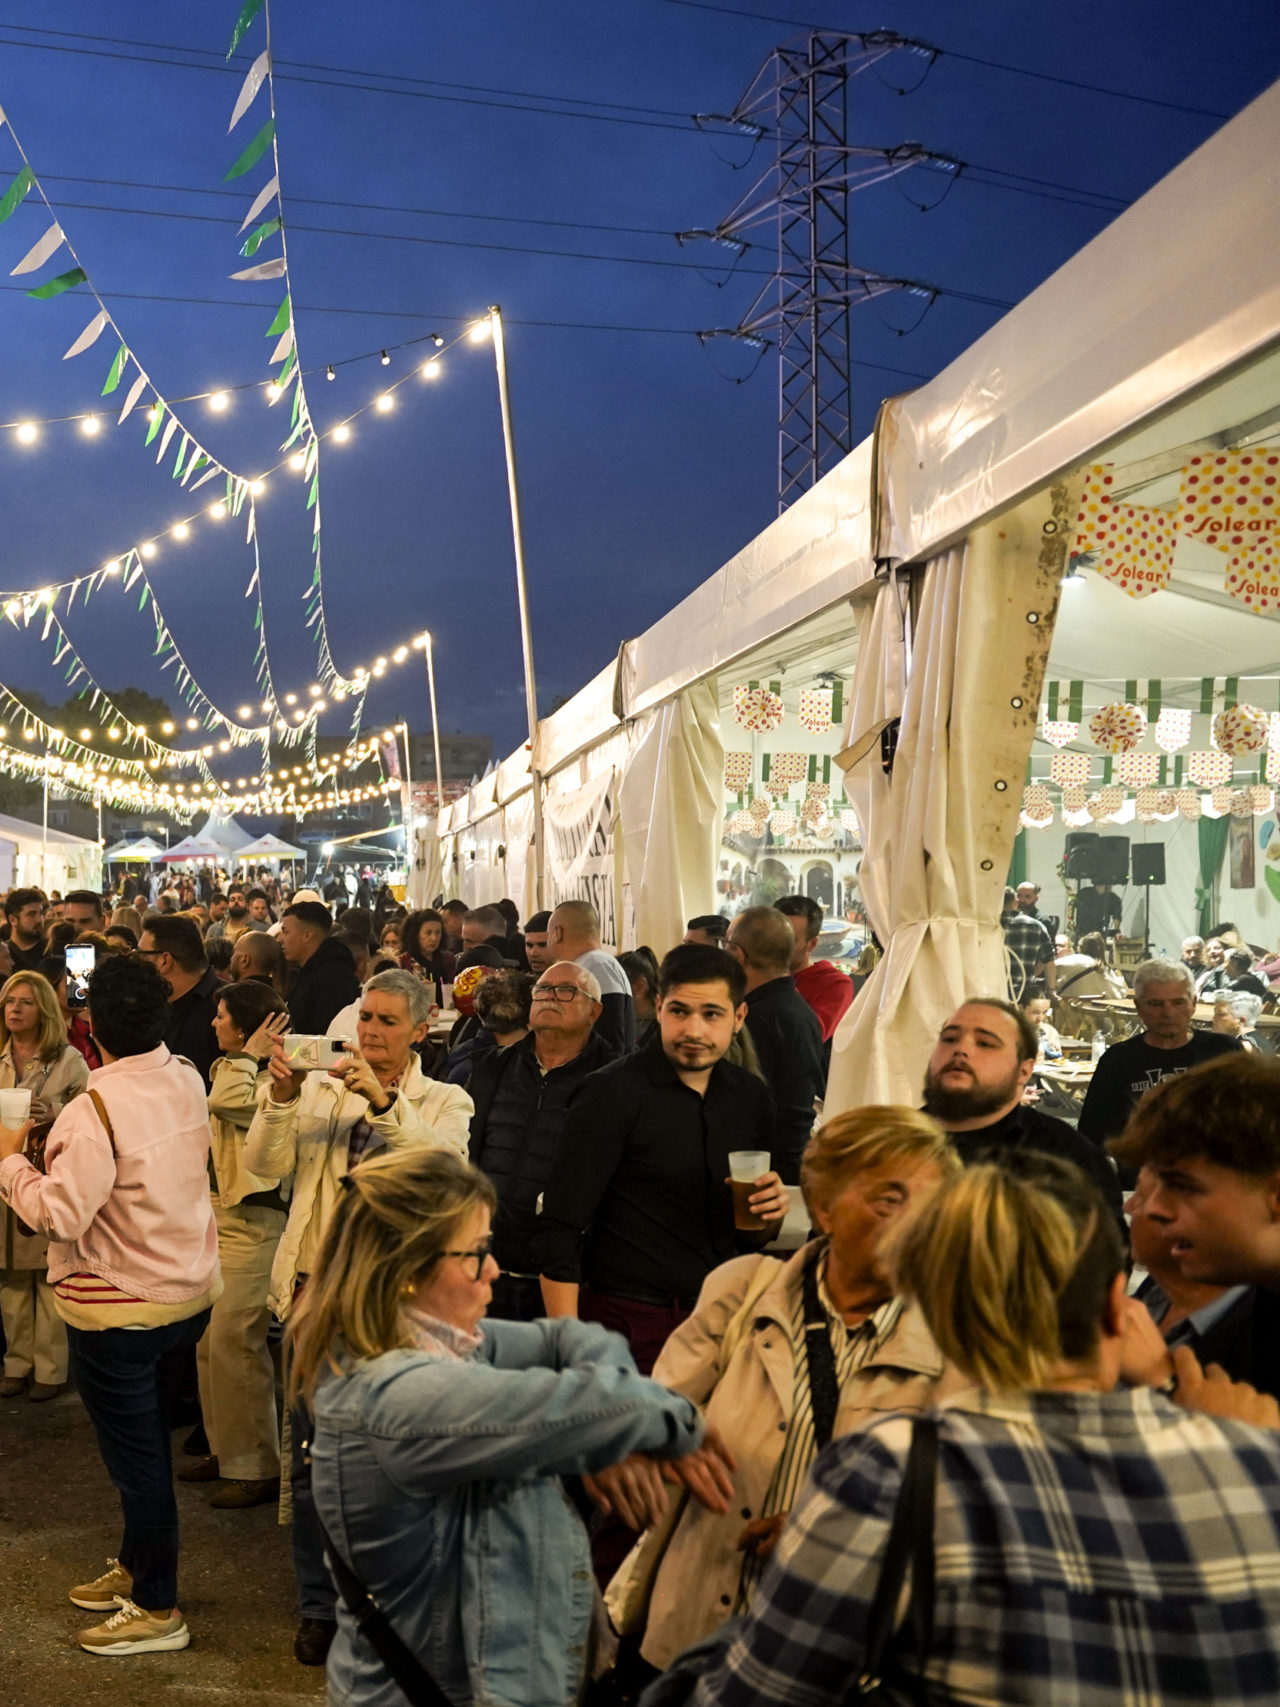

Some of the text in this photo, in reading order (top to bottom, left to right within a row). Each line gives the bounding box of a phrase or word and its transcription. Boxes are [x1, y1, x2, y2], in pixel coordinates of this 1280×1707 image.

[1192, 515, 1279, 535] Solear
[1111, 562, 1163, 584] Solear
[1235, 578, 1280, 598] Solea
